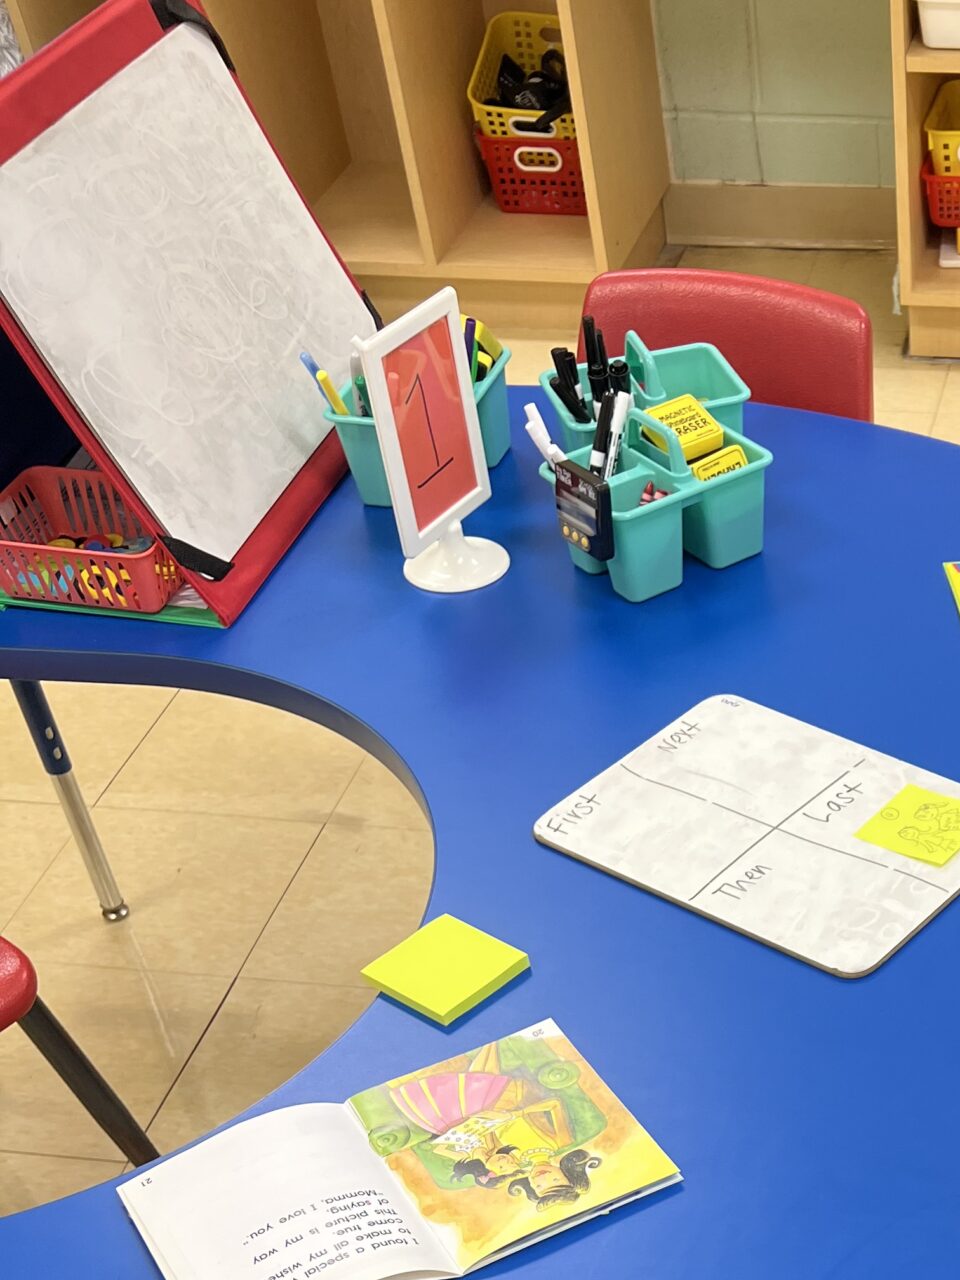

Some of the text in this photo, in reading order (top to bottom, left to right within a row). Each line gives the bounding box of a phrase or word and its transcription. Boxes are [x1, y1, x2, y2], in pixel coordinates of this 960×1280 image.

[658, 405, 696, 421] MAGNETIC
[405, 373, 454, 489] 1
[657, 720, 701, 754] Next
[802, 782, 863, 823] Last
[546, 793, 602, 835] First
[712, 863, 772, 900] Then
[141, 1177, 152, 1187] 21
[310, 1203, 318, 1211] I
[377, 1198, 390, 1206] of
[278, 1208, 307, 1224] love
[332, 1216, 404, 1236] come true.
[398, 1227, 412, 1235] to
[252, 1207, 398, 1265] This picture is my way
[355, 1228, 393, 1242] make
[333, 1239, 349, 1251] all
[355, 1246, 366, 1254] a
[371, 1237, 410, 1251] found
[308, 1248, 328, 1262] my
[304, 1252, 350, 1279] special
